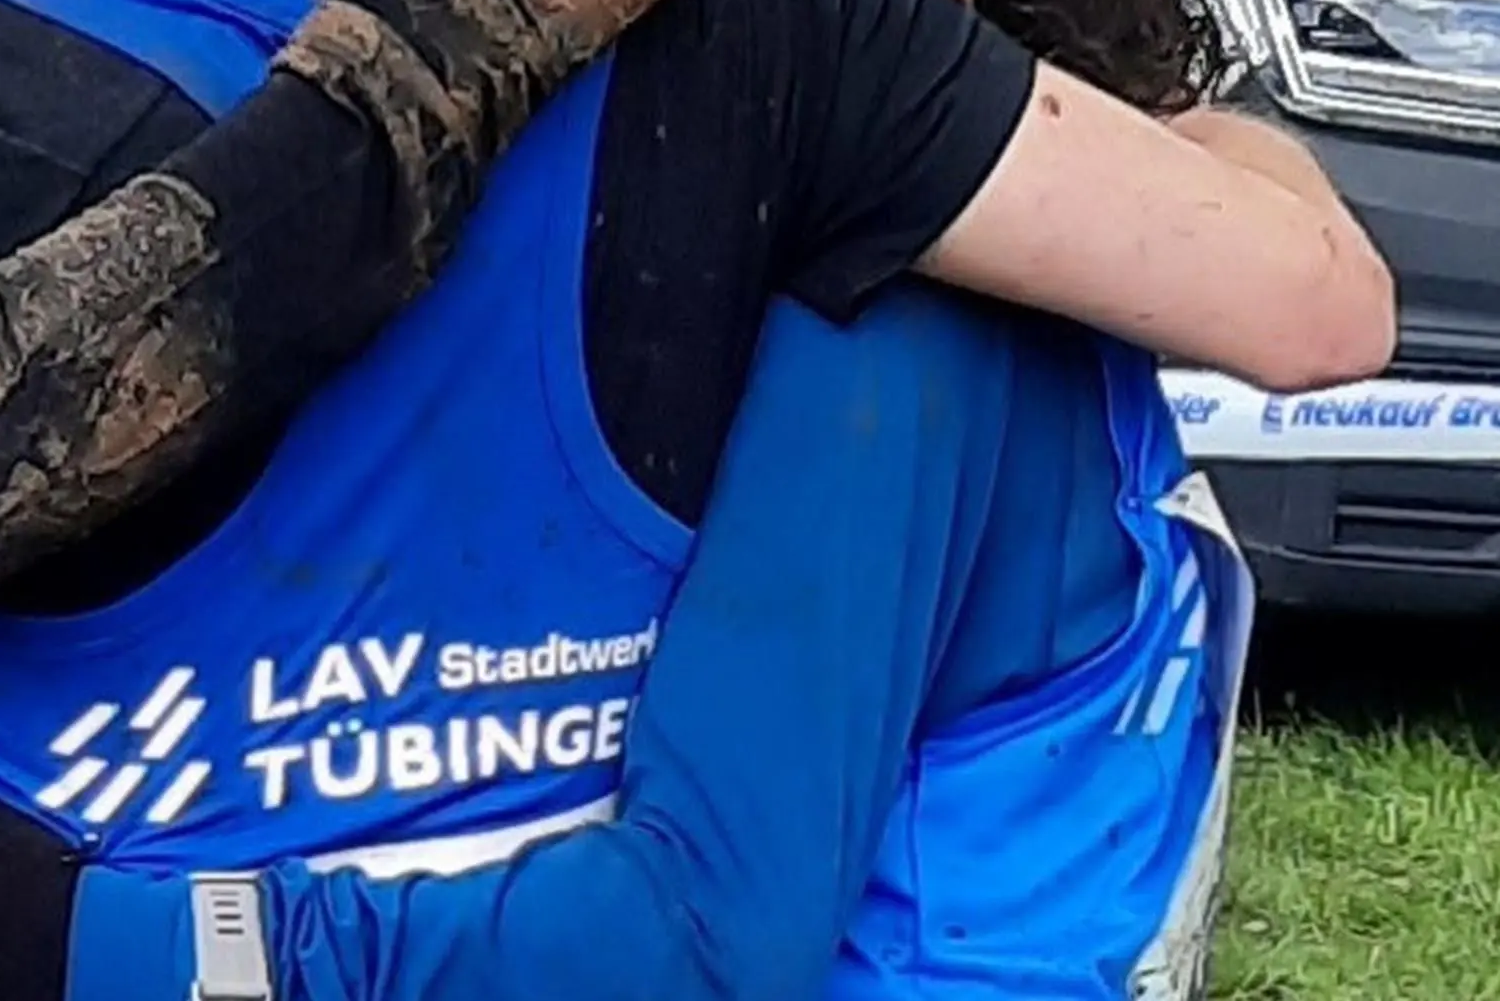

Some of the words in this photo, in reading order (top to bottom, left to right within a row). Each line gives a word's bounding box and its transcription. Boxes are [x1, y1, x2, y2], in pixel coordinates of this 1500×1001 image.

[1290, 392, 1446, 427] neukauf
[251, 632, 425, 723] LAV
[244, 697, 634, 810] TÜBINGE
